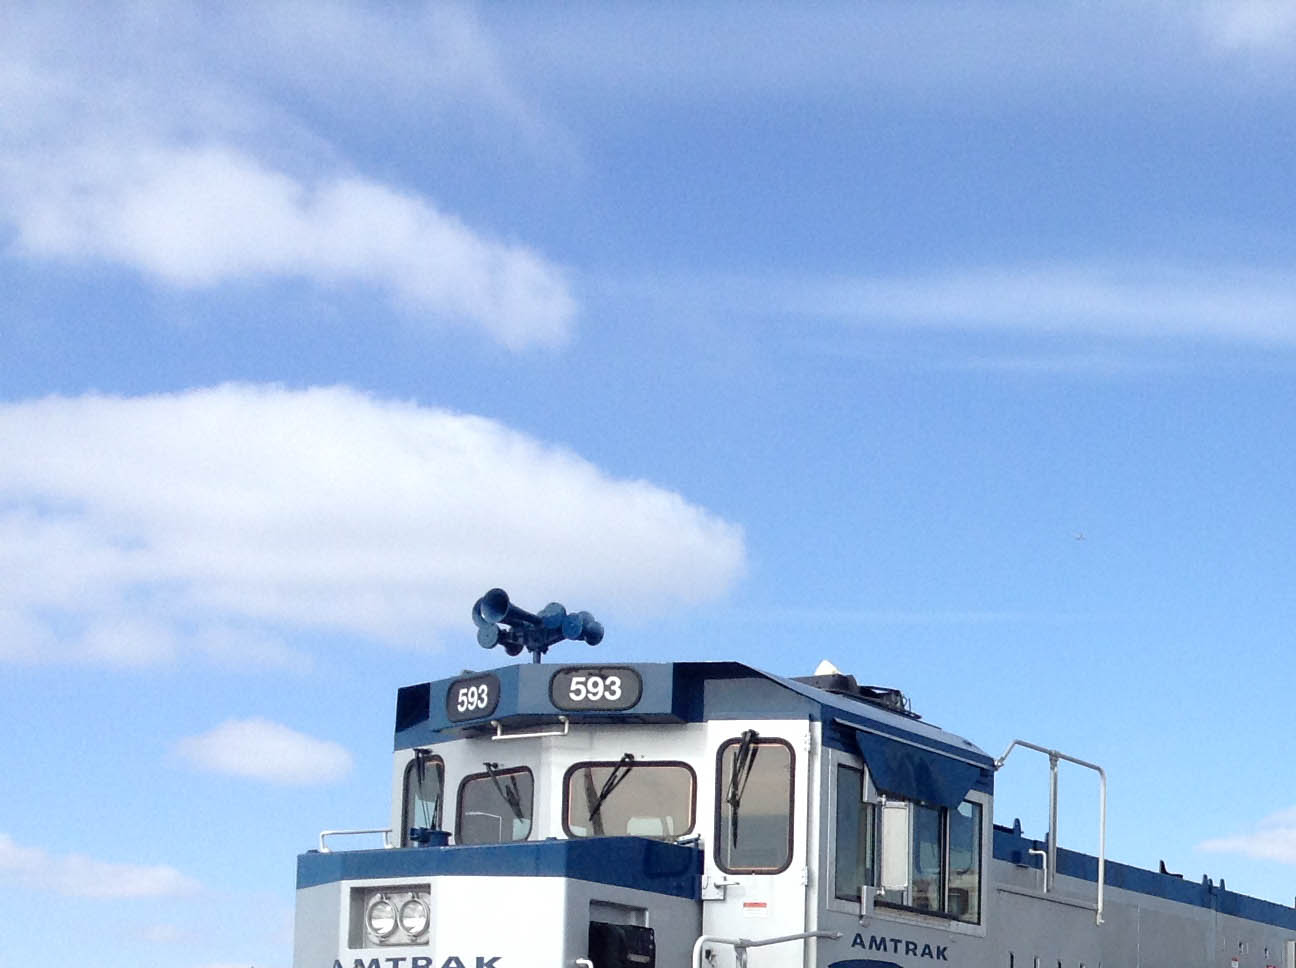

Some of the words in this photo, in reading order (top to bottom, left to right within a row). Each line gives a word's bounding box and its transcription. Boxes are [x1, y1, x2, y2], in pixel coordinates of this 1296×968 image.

[457, 684, 488, 712] 593
[568, 676, 622, 701] 593
[851, 932, 949, 961] AMTRAK
